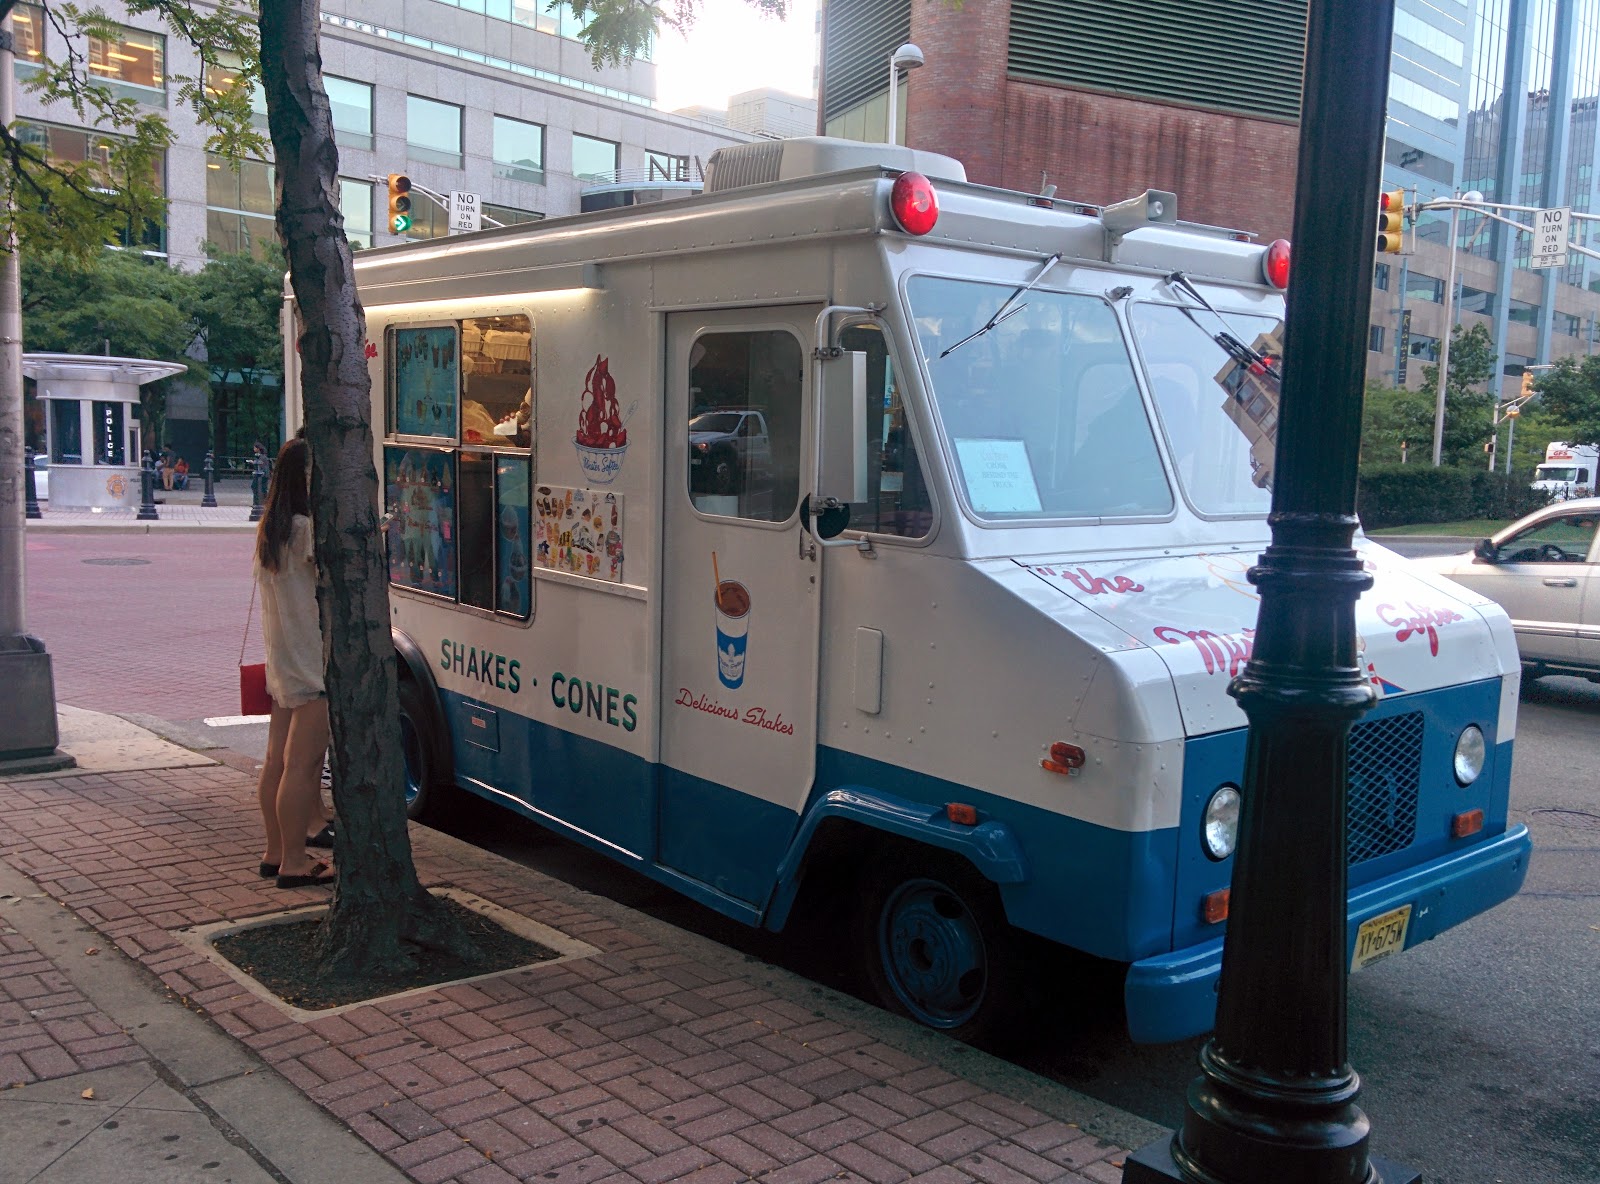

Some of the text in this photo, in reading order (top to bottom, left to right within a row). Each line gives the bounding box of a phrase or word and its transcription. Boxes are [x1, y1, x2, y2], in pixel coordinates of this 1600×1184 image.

[458, 193, 474, 204] NO
[456, 204, 475, 213] TURN
[460, 213, 471, 221] ON
[1543, 211, 1562, 224] NO
[458, 221, 473, 229] RED
[1541, 224, 1562, 234] TURN
[1545, 235, 1557, 243] ON
[1542, 245, 1559, 253] RED
[105, 409, 114, 458] POLICE
[440, 638, 638, 732] SHAKES CONES
[675, 687, 794, 736] Delicious Shakes
